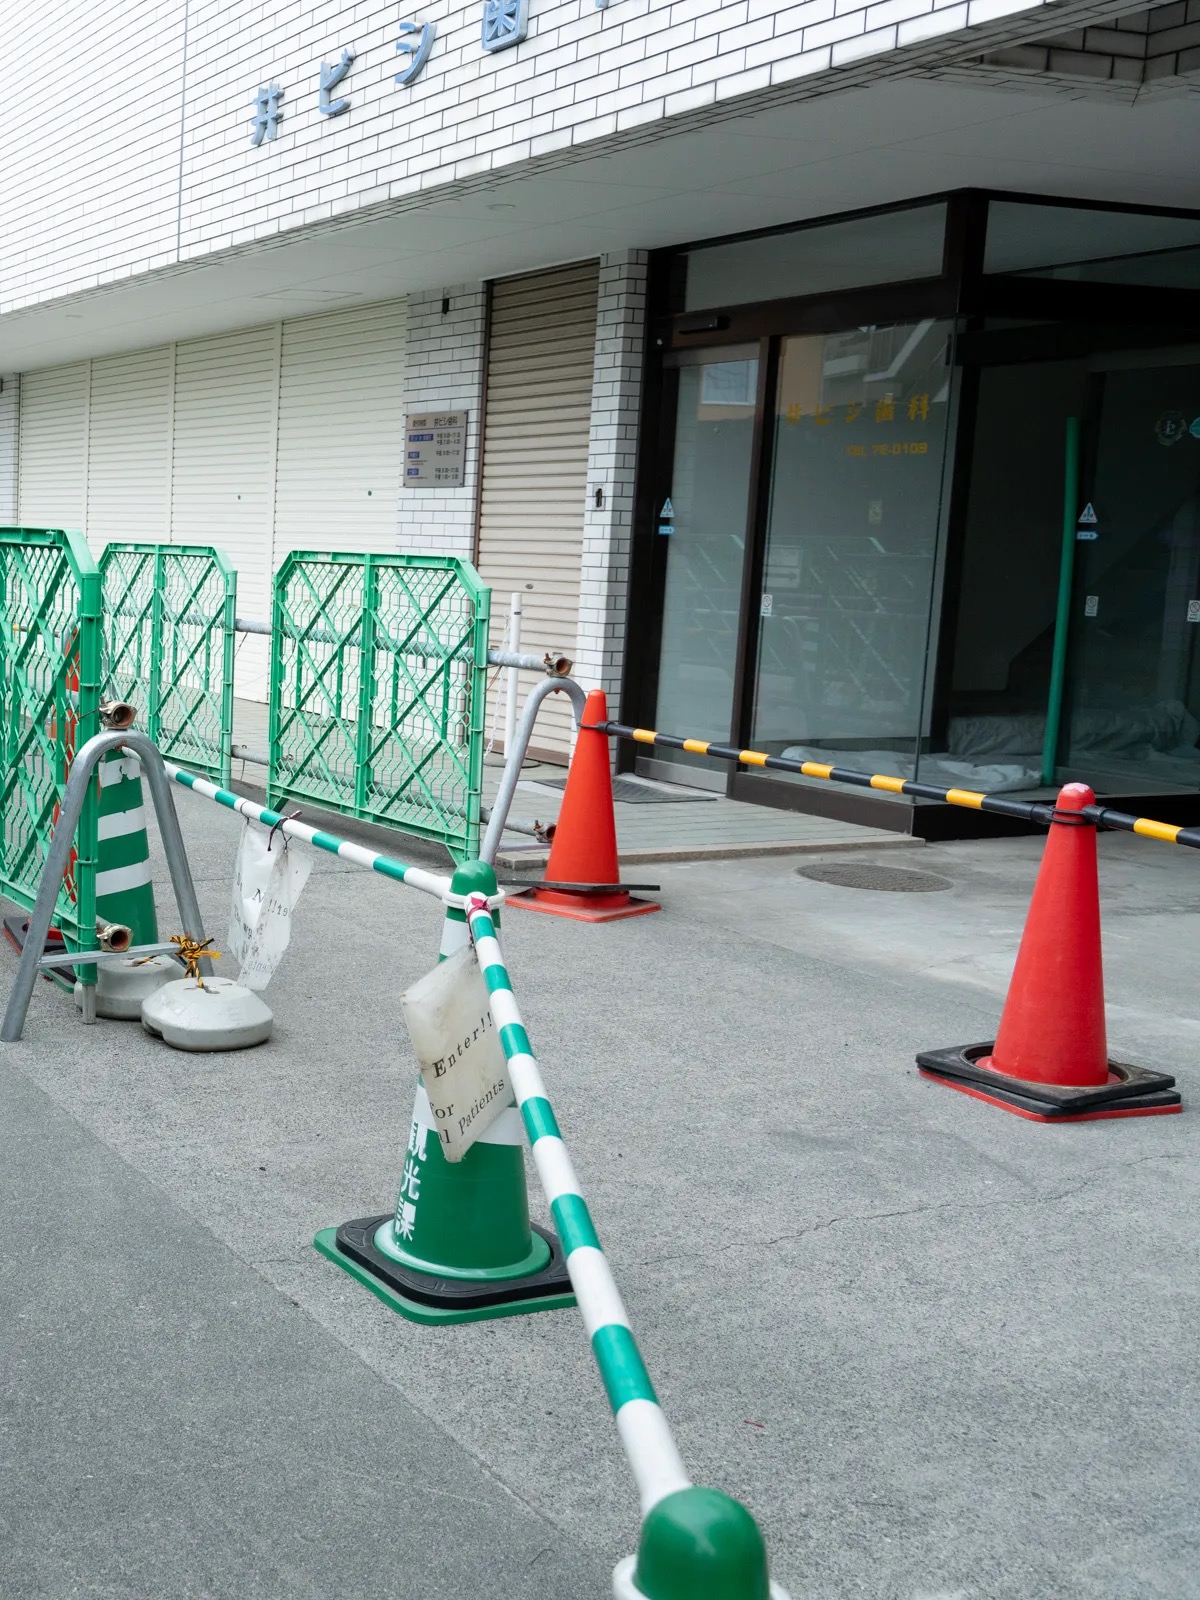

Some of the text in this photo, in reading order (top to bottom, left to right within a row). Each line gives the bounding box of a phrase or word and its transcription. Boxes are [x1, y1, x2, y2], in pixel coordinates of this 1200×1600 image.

[250, 0, 612, 147] 井ビシ歯
[785, 394, 929, 426] 井ビシ歯科
[432, 1011, 494, 1079] Enter!!
[457, 1078, 506, 1137] Patients
